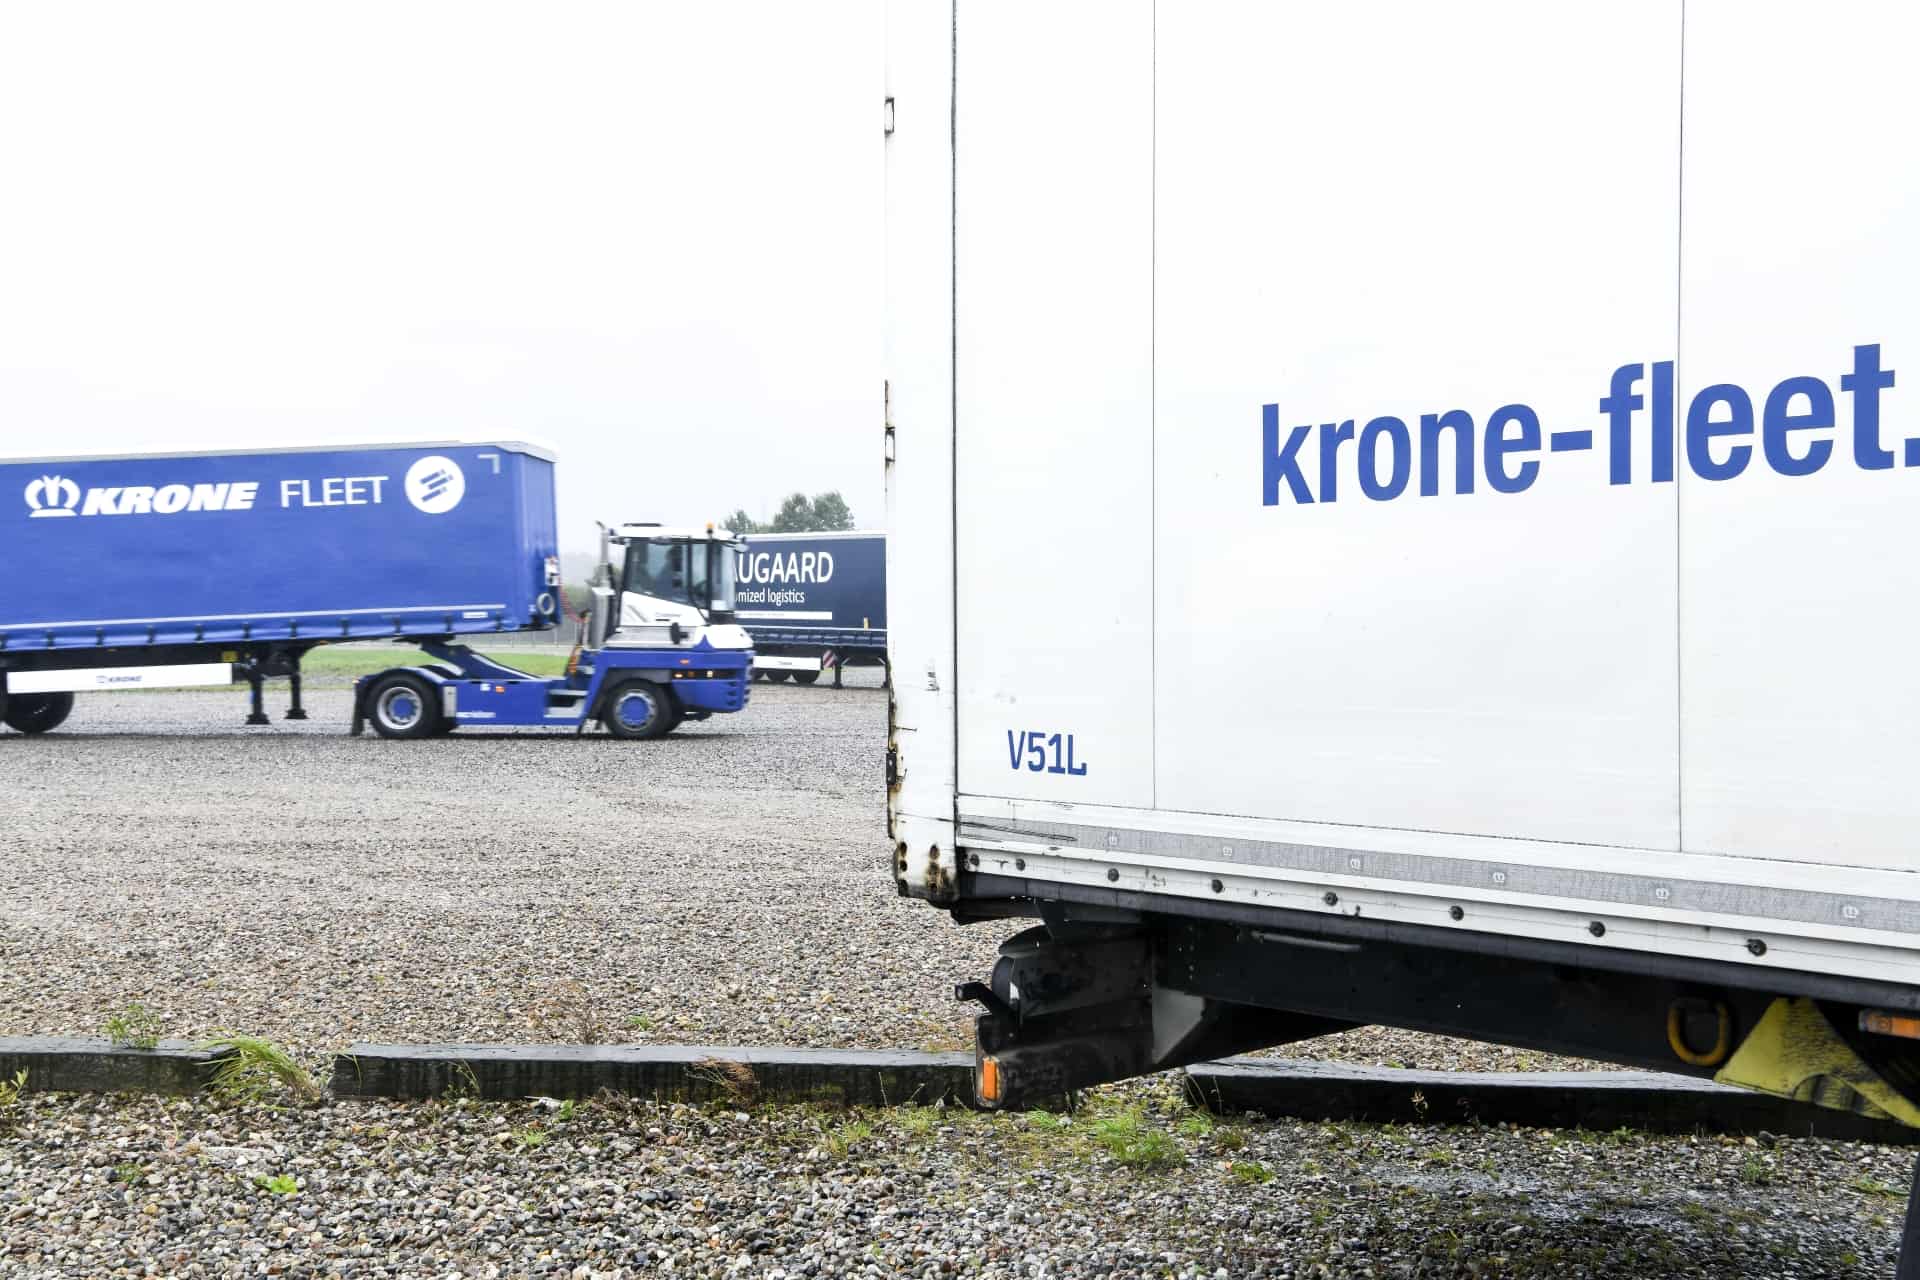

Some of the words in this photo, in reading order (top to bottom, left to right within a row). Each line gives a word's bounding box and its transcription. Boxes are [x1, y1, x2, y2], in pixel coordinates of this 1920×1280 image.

[81, 482, 259, 516] KRONE
[280, 476, 388, 507] FLEET
[735, 551, 834, 584] UGAARD
[736, 587, 766, 603] mized
[767, 587, 805, 607] logistics
[1007, 729, 1087, 776] V51L
